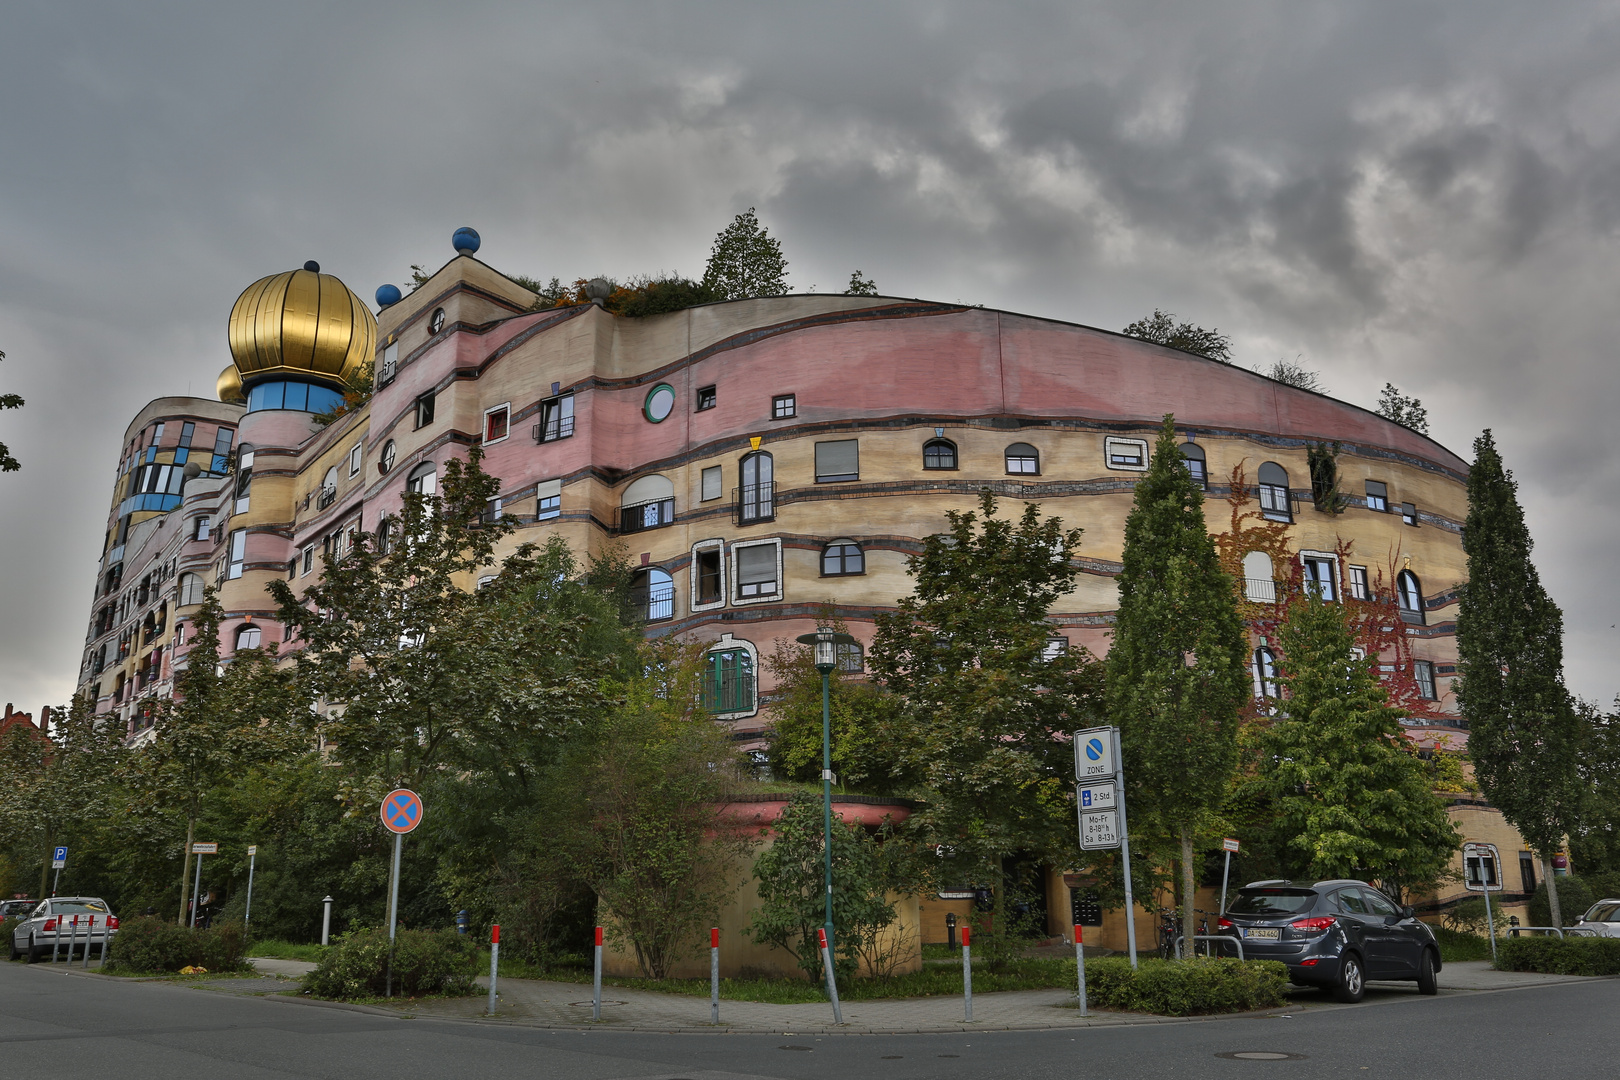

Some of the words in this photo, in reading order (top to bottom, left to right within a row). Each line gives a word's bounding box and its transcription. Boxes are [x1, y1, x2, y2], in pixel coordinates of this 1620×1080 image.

[1087, 765, 1105, 774] ZONE
[1094, 793, 1098, 801] 2
[1099, 791, 1112, 801] Std.
[1089, 814, 1108, 824] Mo-Fr
[1105, 824, 1110, 832] h
[1085, 835, 1094, 843] Sa
[56, 848, 65, 859] P
